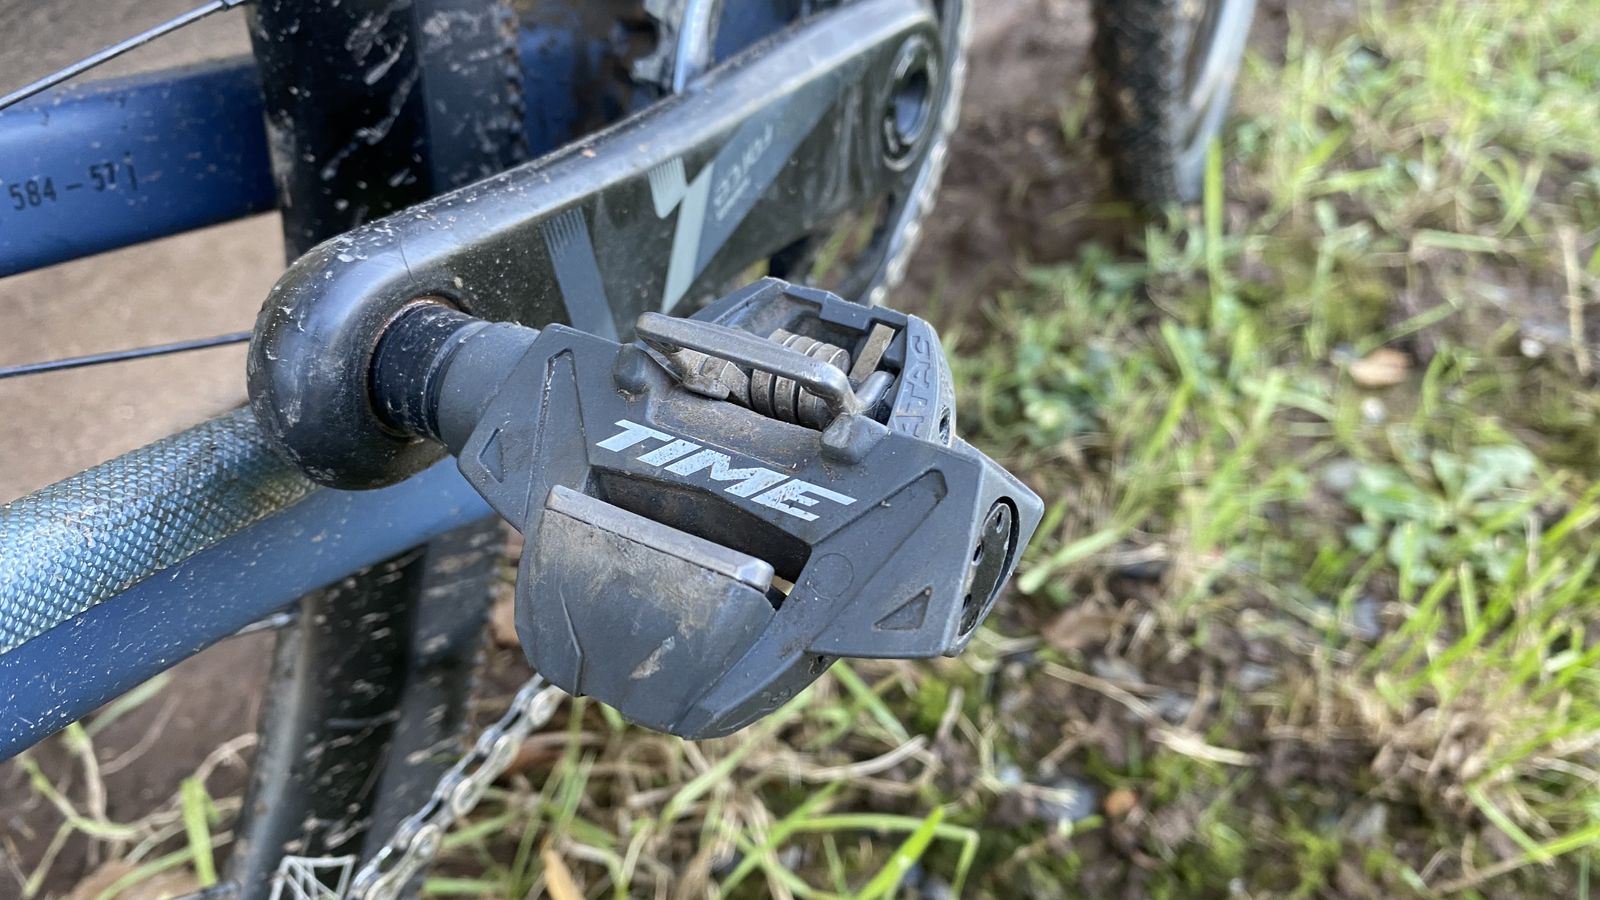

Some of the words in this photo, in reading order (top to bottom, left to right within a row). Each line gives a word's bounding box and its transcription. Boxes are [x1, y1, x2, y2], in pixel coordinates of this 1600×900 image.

[8, 176, 57, 212] 584
[893, 334, 931, 438] ATAC
[595, 418, 858, 523] TIME
